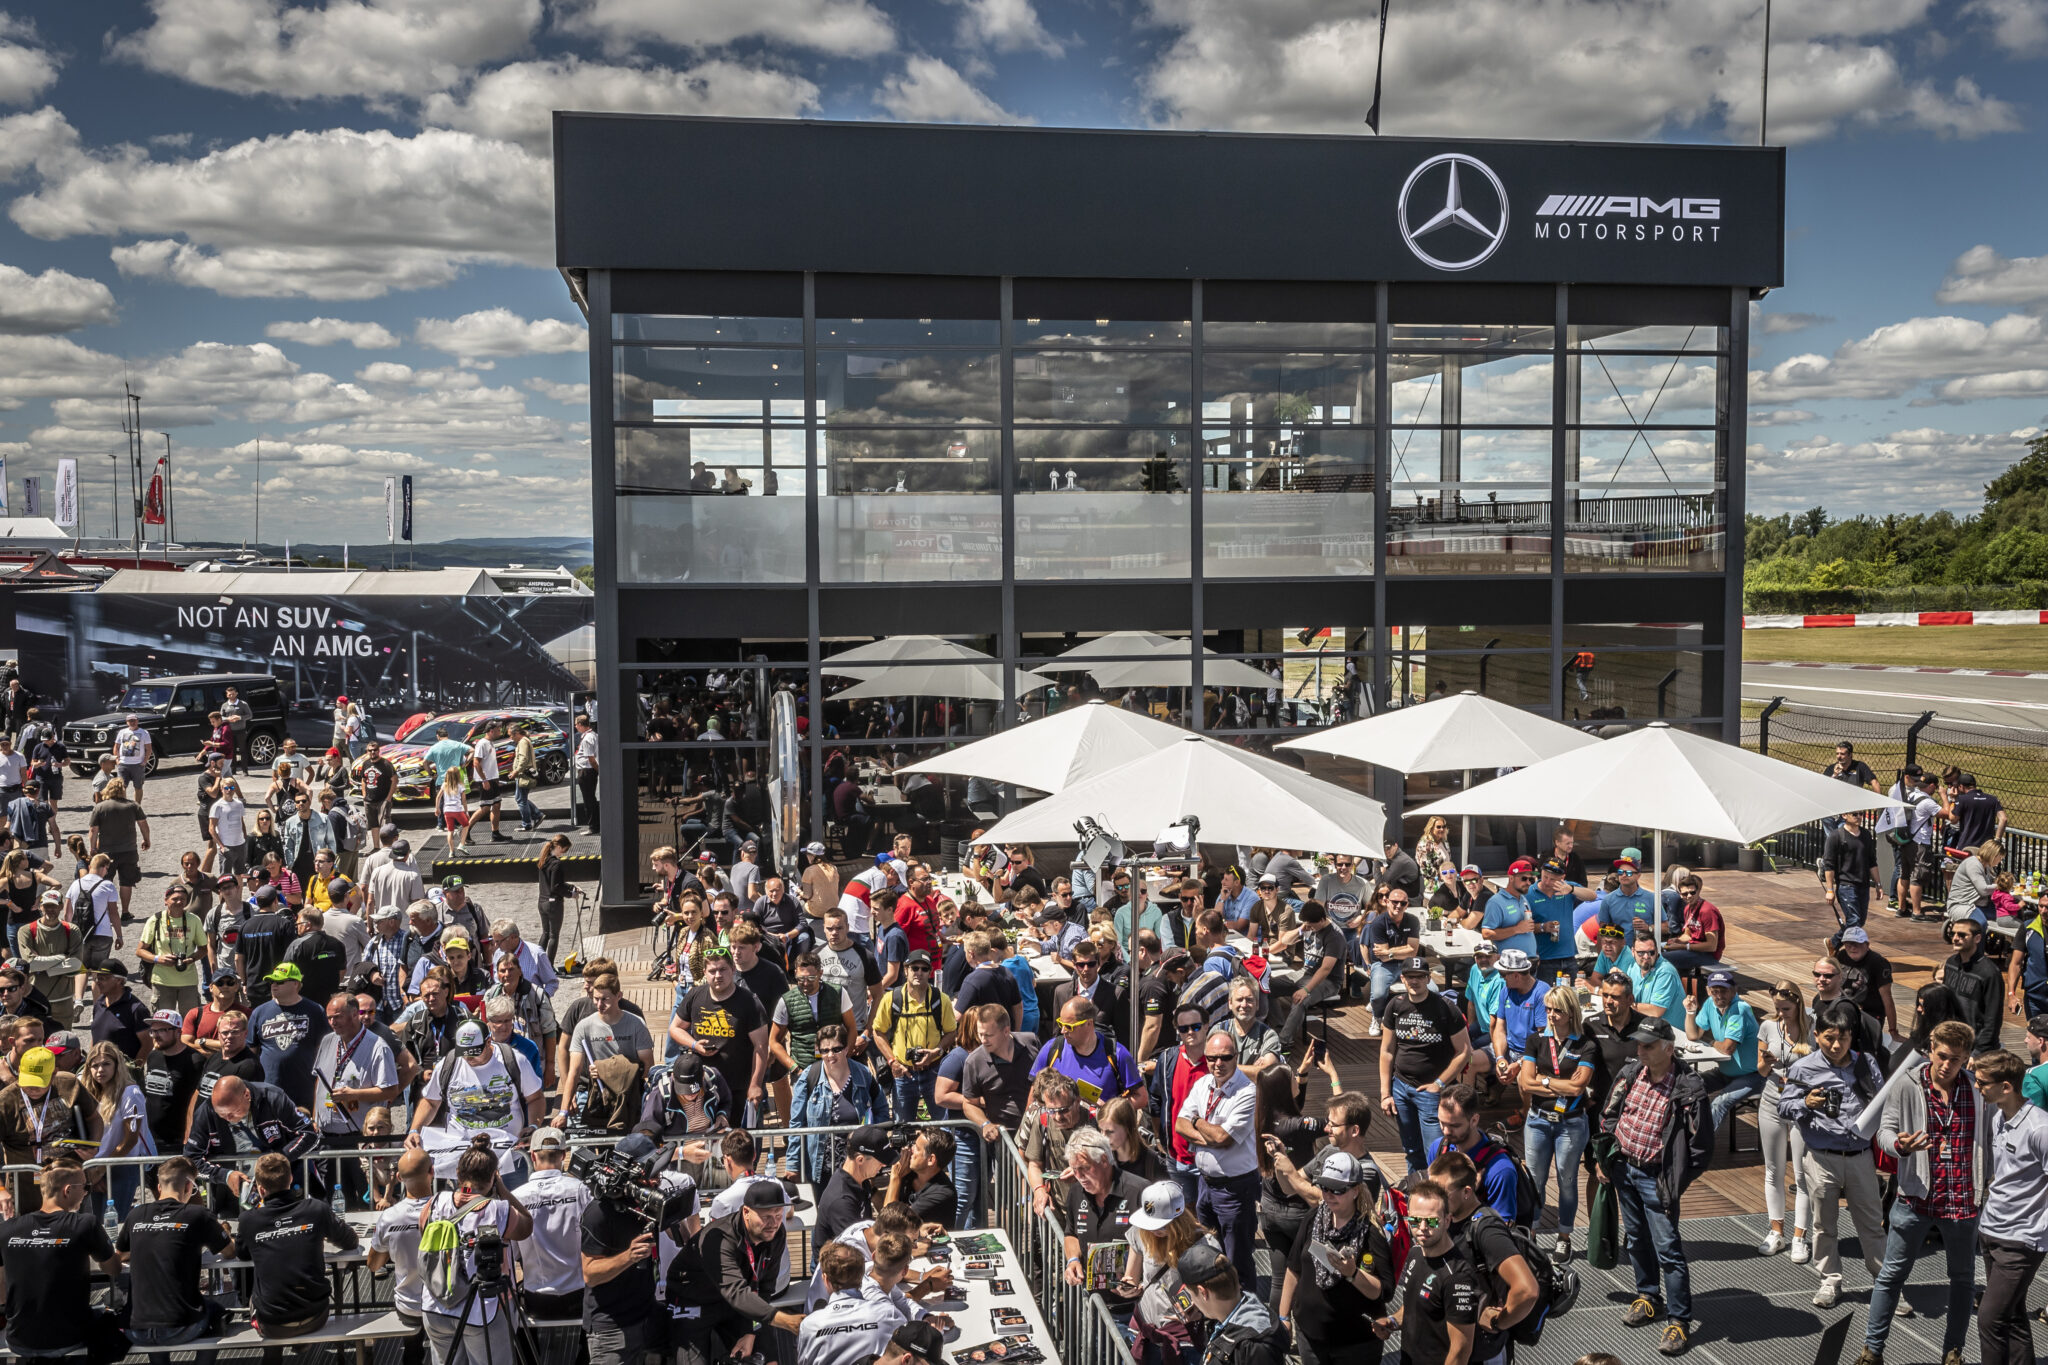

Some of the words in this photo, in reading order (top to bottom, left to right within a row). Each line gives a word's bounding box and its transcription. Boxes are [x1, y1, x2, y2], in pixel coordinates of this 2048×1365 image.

[1595, 195, 1721, 220] AMG
[1535, 222, 1721, 242] MOTORSPORT
[178, 606, 228, 628] NOT
[235, 606, 269, 628] AN
[276, 606, 338, 629] SUV.
[270, 634, 305, 656] AN
[313, 635, 380, 657] AMG.
[1413, 957, 1421, 969] B
[696, 1026, 736, 1038] adidas
[540, 1196, 577, 1207] AMG
[833, 1322, 879, 1335] AMG
